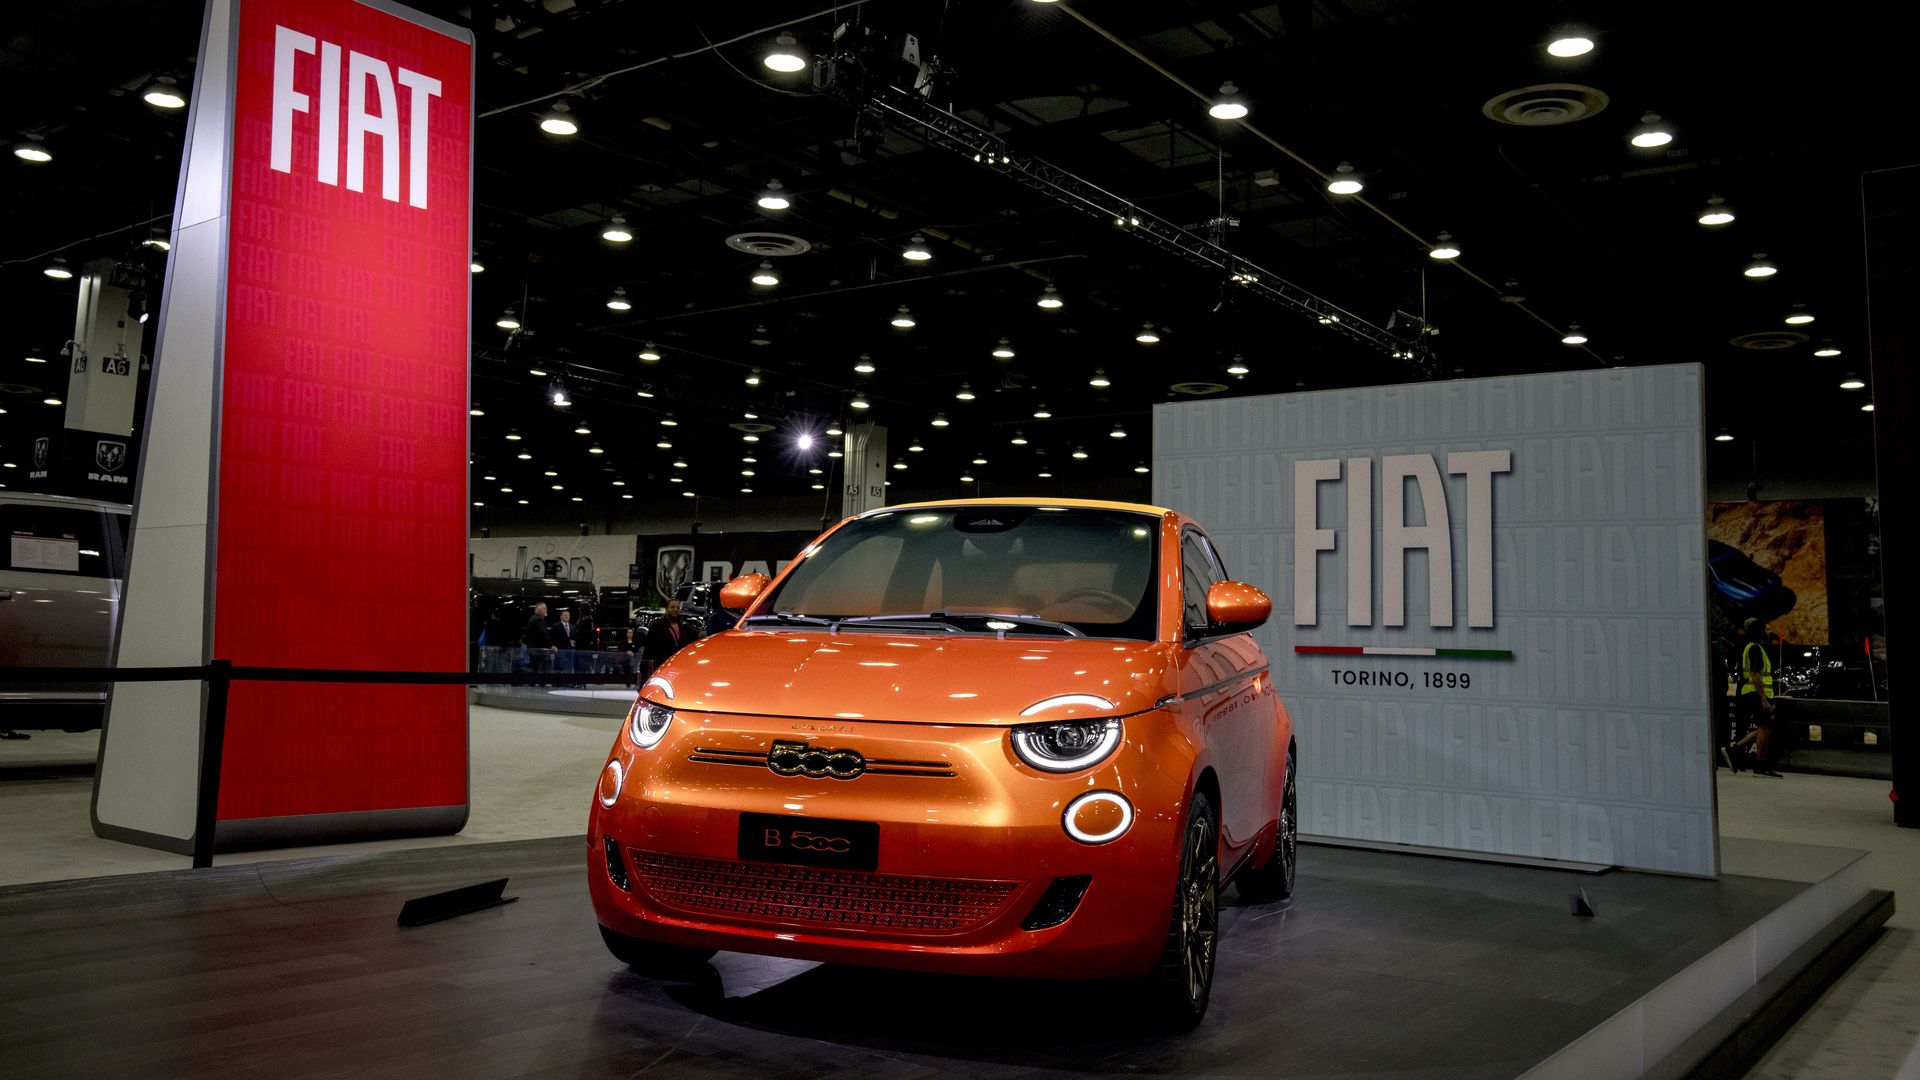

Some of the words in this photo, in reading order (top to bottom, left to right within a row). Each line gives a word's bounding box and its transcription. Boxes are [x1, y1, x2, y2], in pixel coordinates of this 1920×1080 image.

[270, 24, 442, 210] FIAT
[106, 360, 127, 375] A6
[29, 470, 48, 479] RAM
[88, 472, 129, 484] RAM
[1294, 450, 1511, 628] FIAT
[1332, 670, 1414, 689] TORINO,
[1424, 672, 1470, 689] 1899
[769, 740, 865, 779] 500
[790, 830, 853, 853] 500
